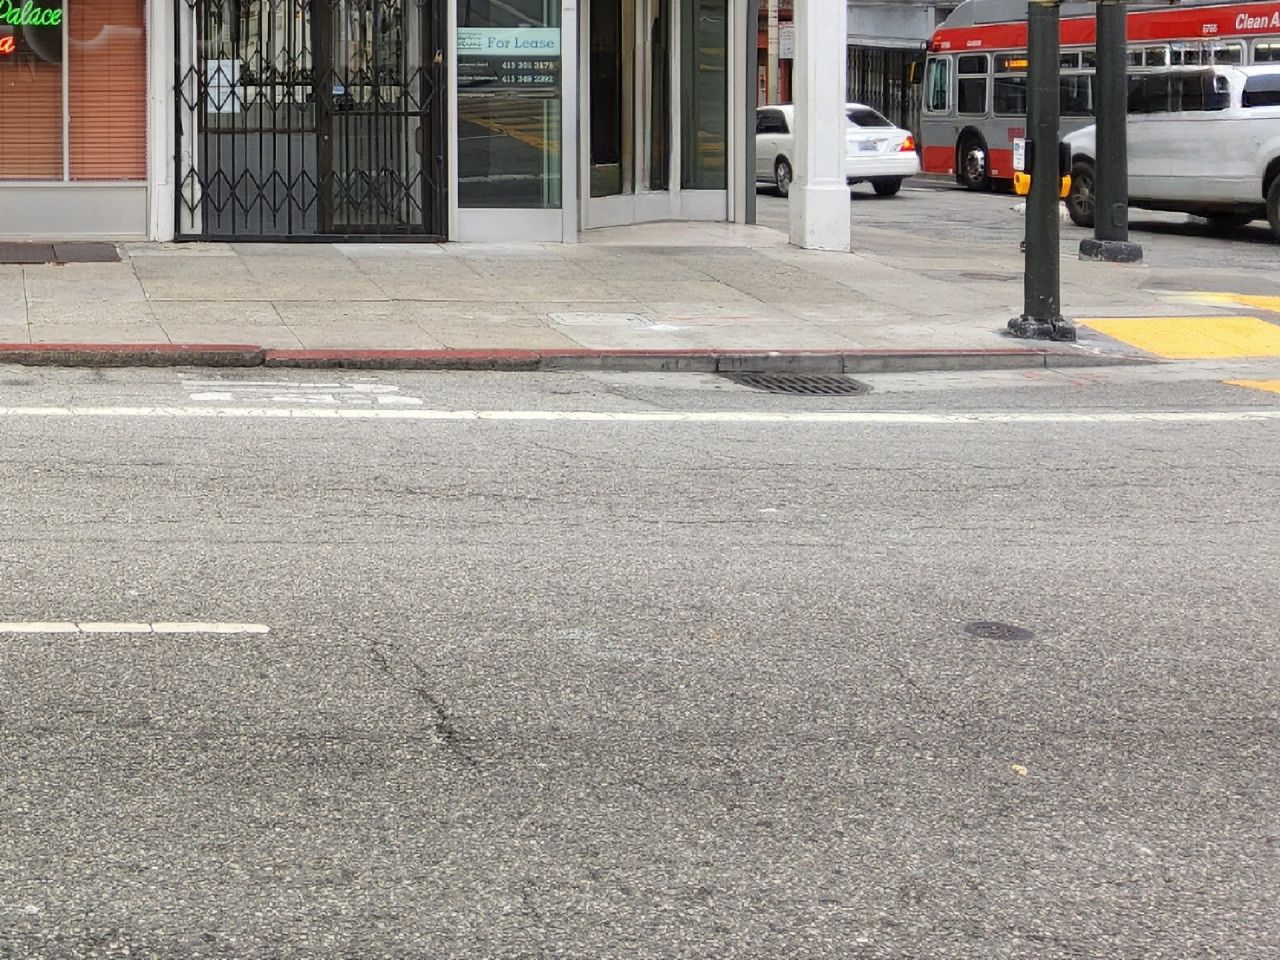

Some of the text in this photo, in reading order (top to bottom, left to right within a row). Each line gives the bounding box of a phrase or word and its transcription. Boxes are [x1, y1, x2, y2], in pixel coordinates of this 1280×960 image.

[1235, 13, 1268, 29] Clean
[488, 37, 510, 49] For
[515, 37, 555, 49] Lease
